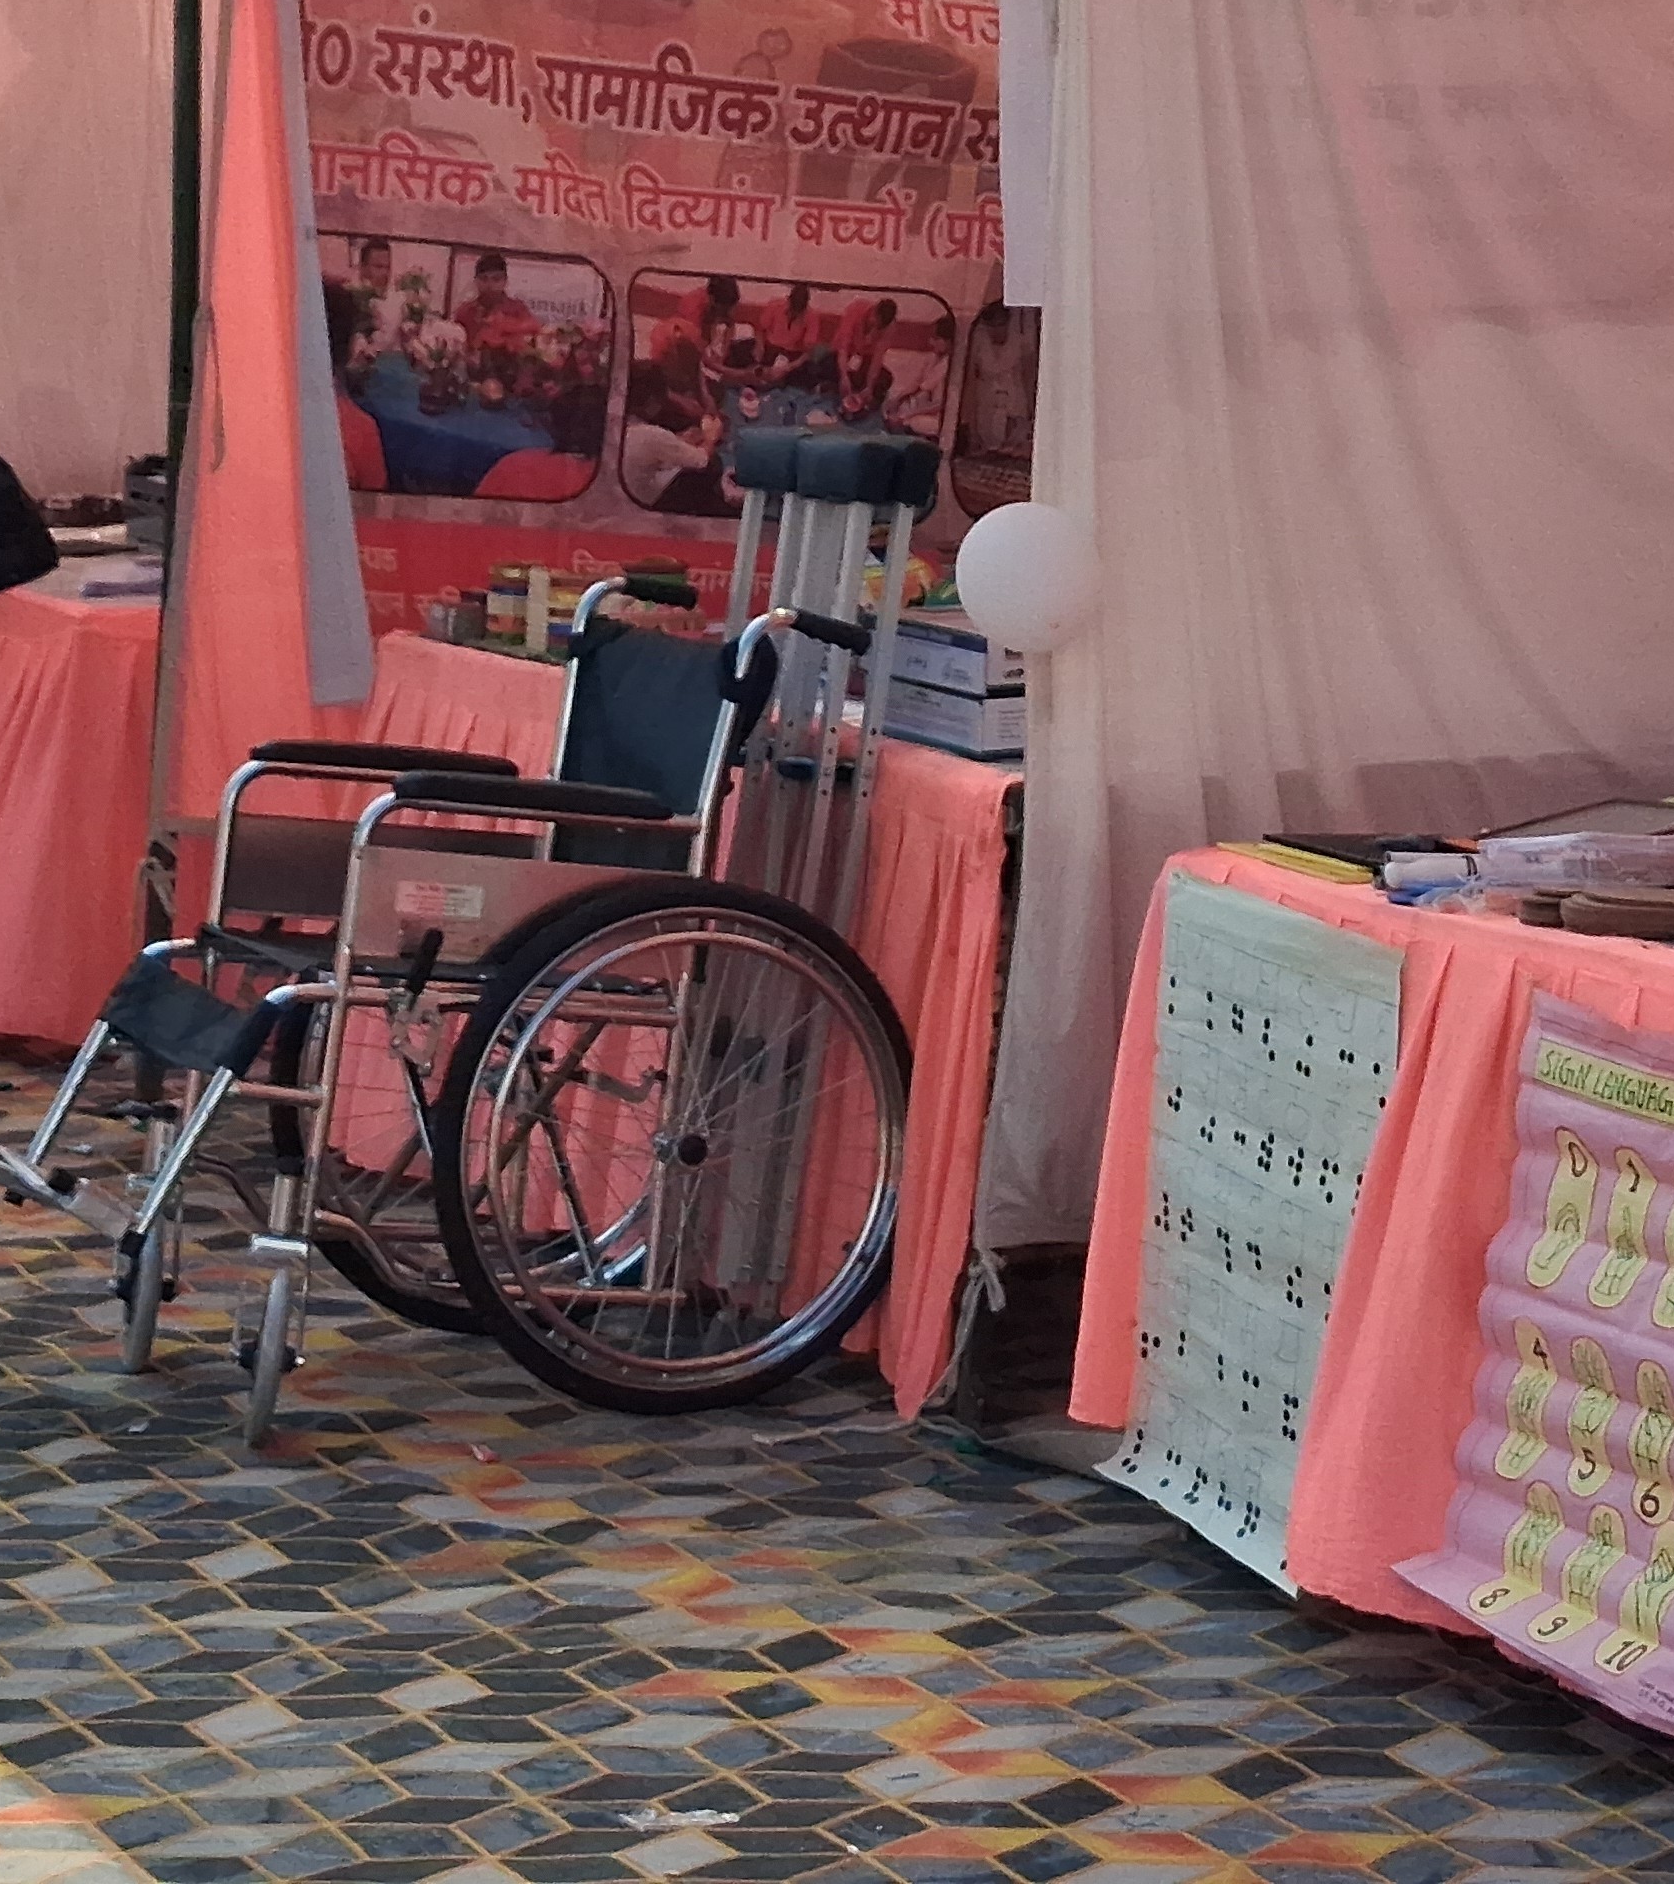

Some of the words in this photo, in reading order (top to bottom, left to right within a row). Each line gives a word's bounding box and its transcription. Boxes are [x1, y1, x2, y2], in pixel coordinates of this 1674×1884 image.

[376, 9, 531, 124] संस्था,
[536, 41, 778, 140] सामाजिक
[789, 84, 961, 160] उत्थान
[622, 164, 779, 242] दिव्यांग
[795, 189, 914, 253] बच्चों
[1540, 1049, 1592, 1091] SIGN
[1625, 1157, 1641, 1193] 1
[1532, 1337, 1550, 1372] 4
[1577, 1447, 1598, 1481] 5
[1639, 1480, 1662, 1519] 6
[1478, 1587, 1511, 1609] 8
[1536, 1616, 1568, 1638] 9
[1602, 1639, 1650, 1673] 10
